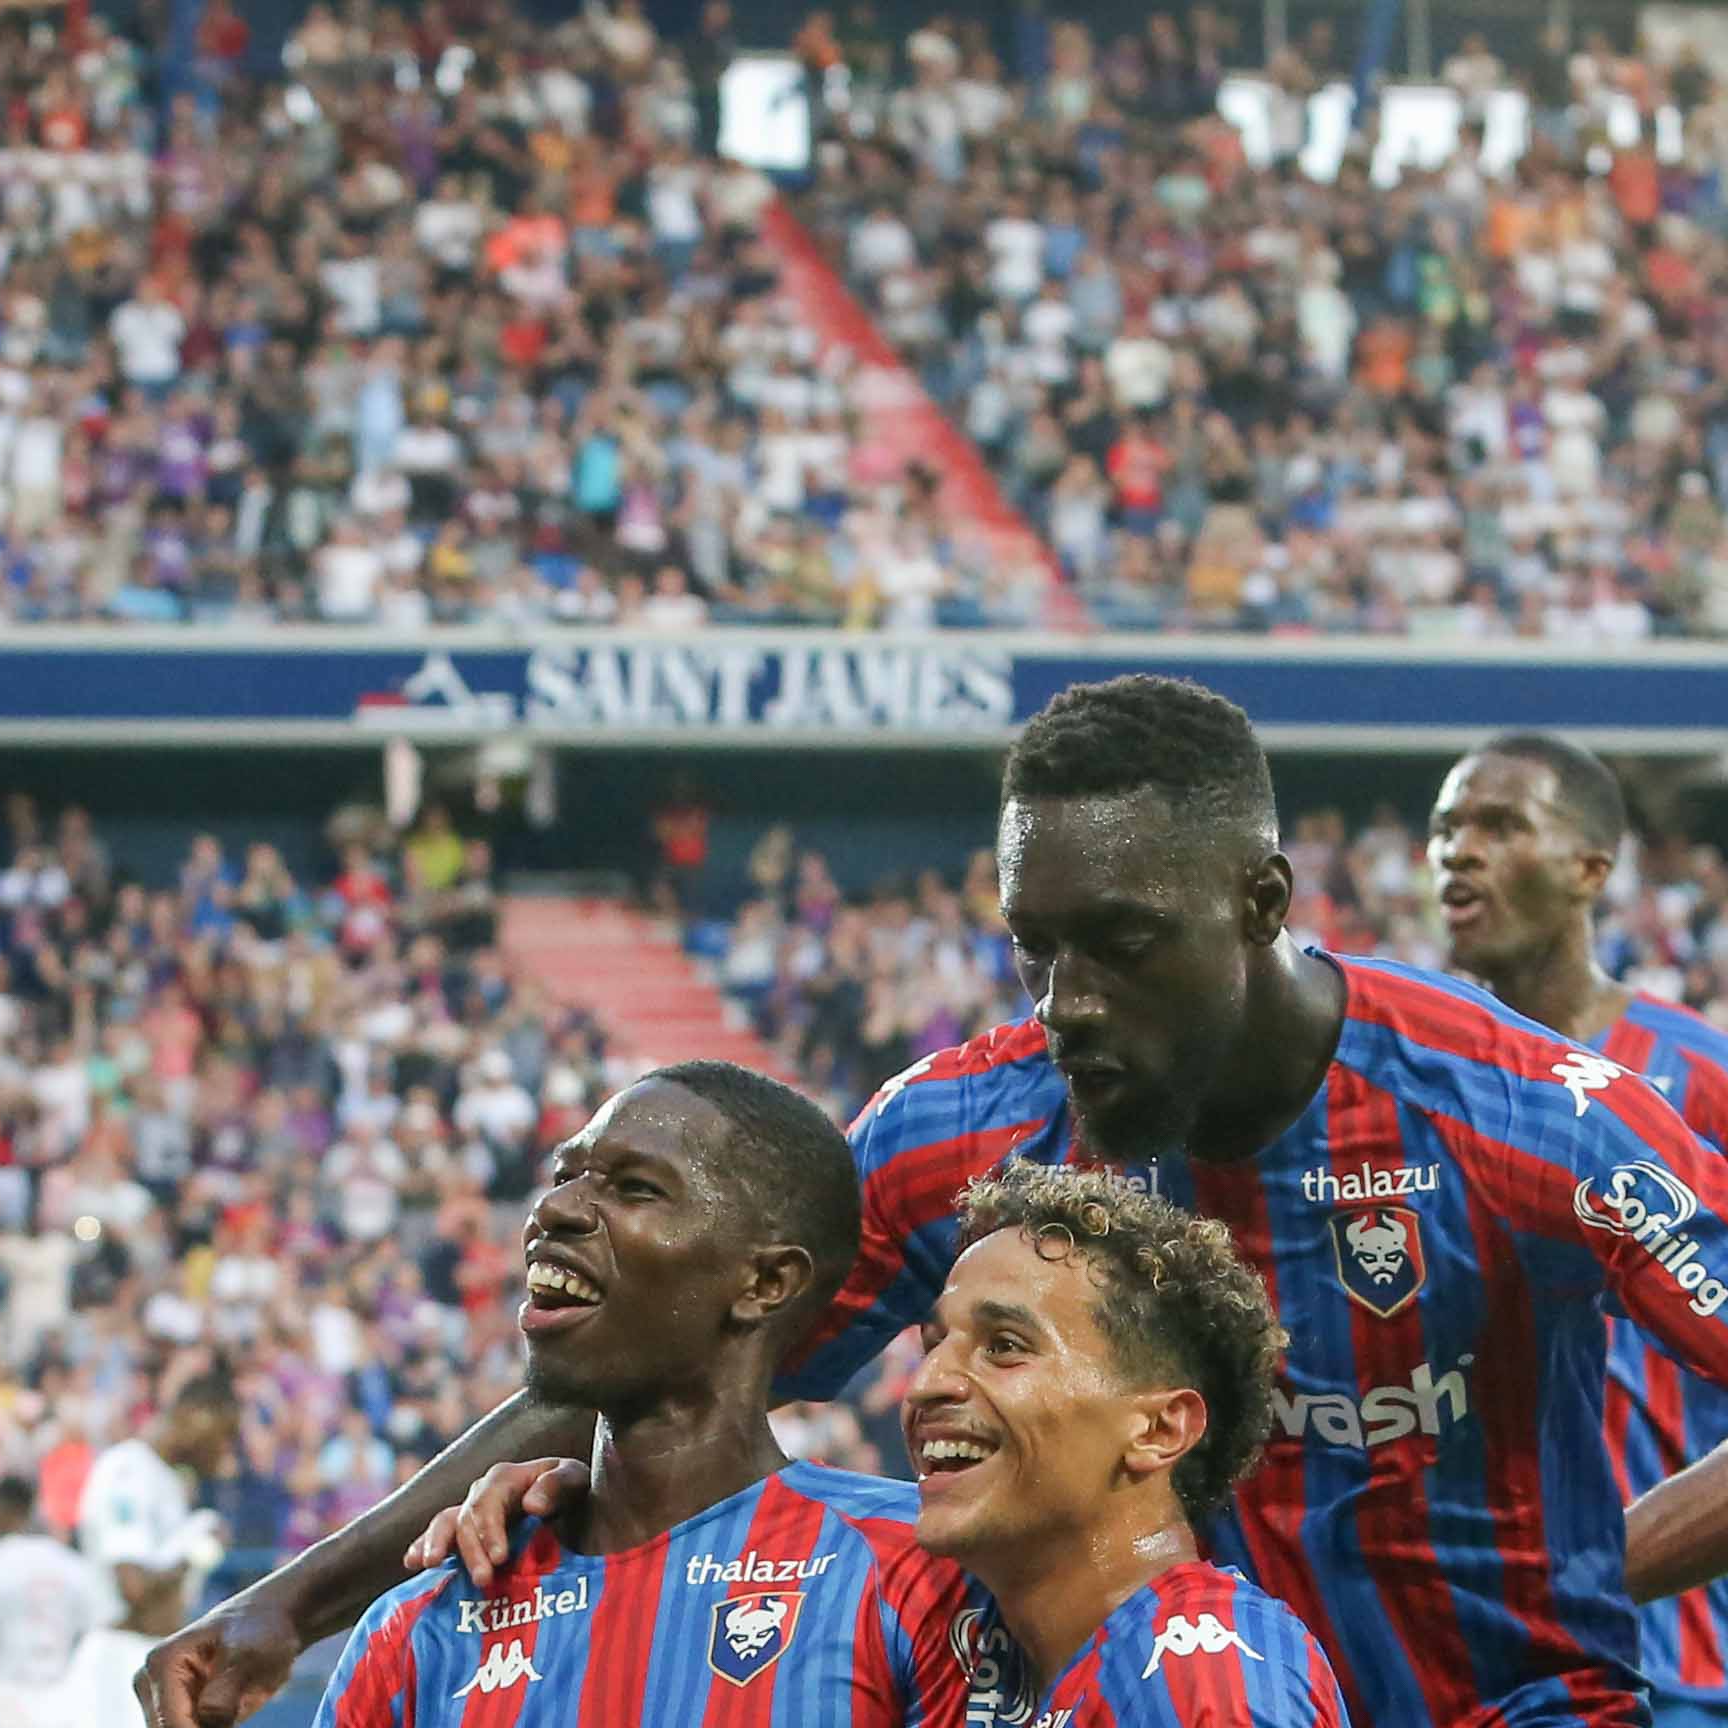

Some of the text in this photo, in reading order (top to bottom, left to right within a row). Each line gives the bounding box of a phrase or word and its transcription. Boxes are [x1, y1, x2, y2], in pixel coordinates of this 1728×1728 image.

[525, 646, 1015, 726] SAINT JAMES
[686, 1550, 838, 1585] thalazur
[456, 1576, 589, 1633] Künkel
